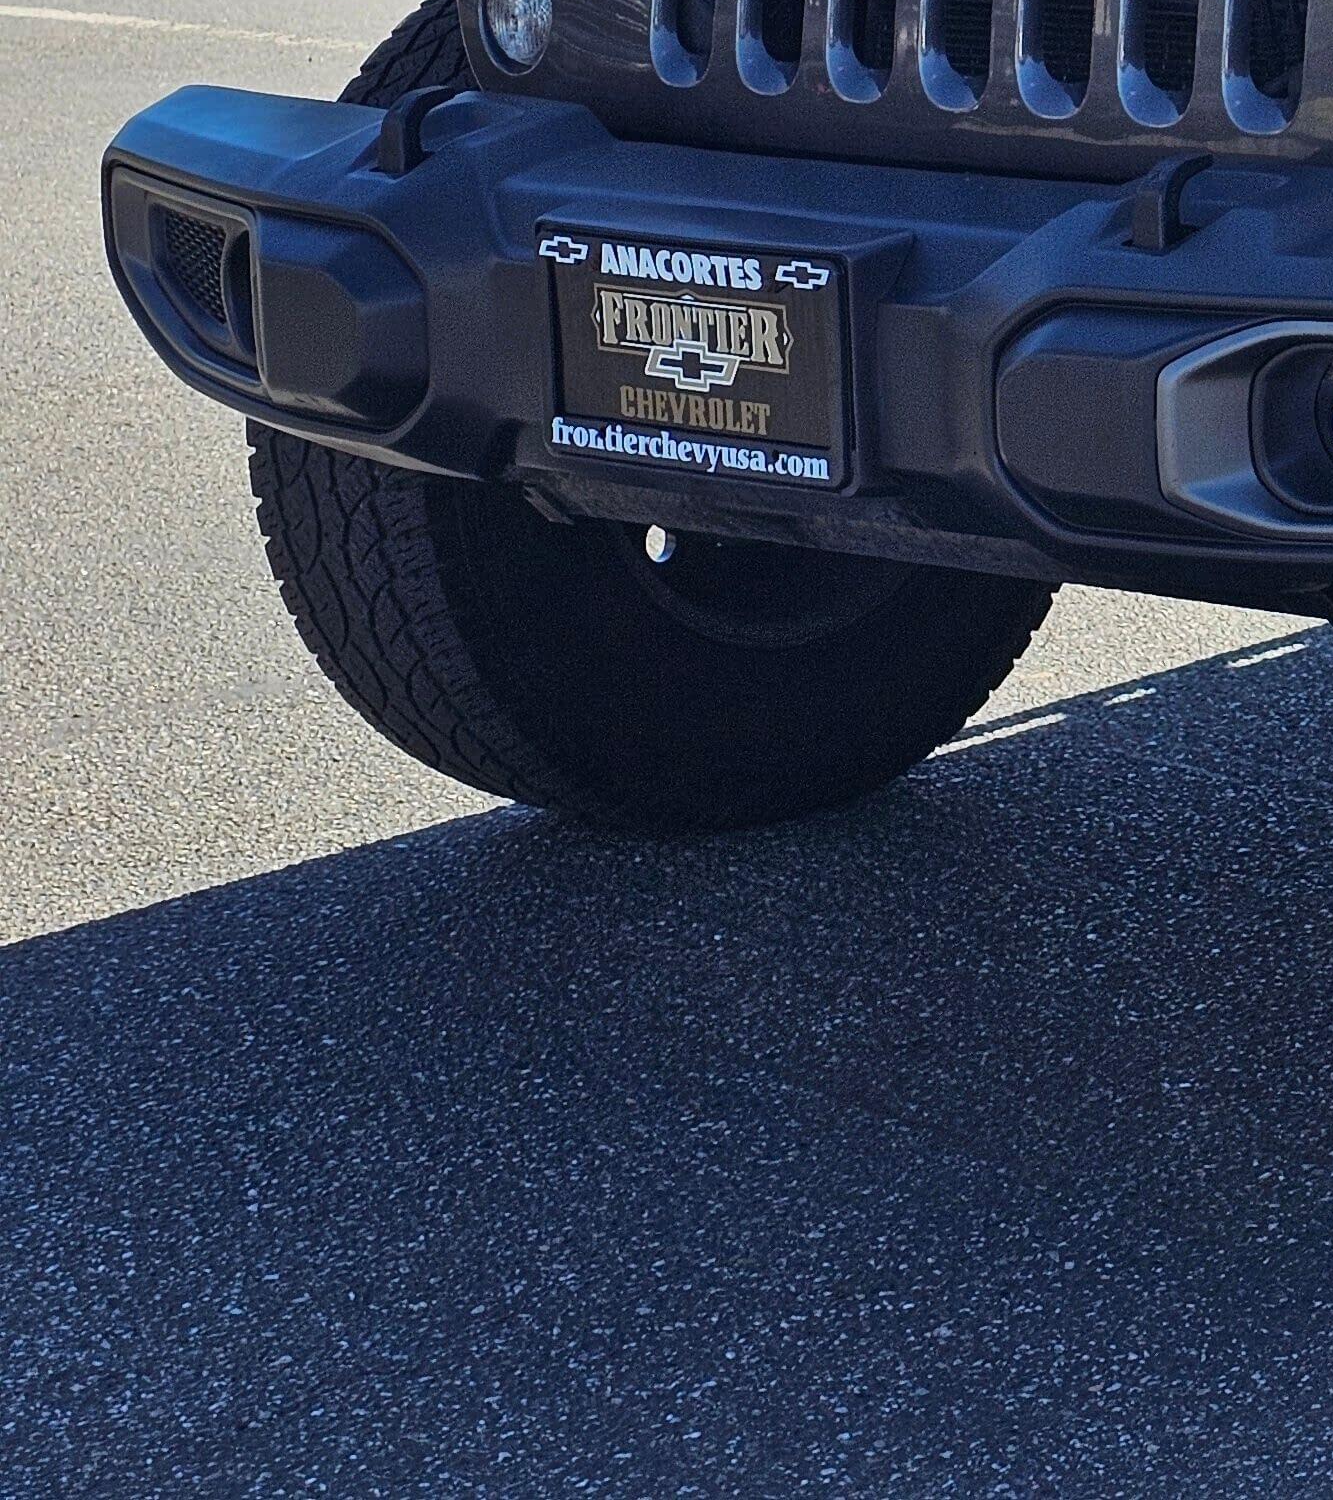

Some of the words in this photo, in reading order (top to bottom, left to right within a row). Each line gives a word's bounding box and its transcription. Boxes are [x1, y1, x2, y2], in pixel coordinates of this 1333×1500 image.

[600, 242, 763, 292] ANACORTES
[598, 290, 785, 366] FRONTIER
[619, 384, 771, 436] CHEVROLET
[550, 416, 830, 481] frontierchevyusa.com
